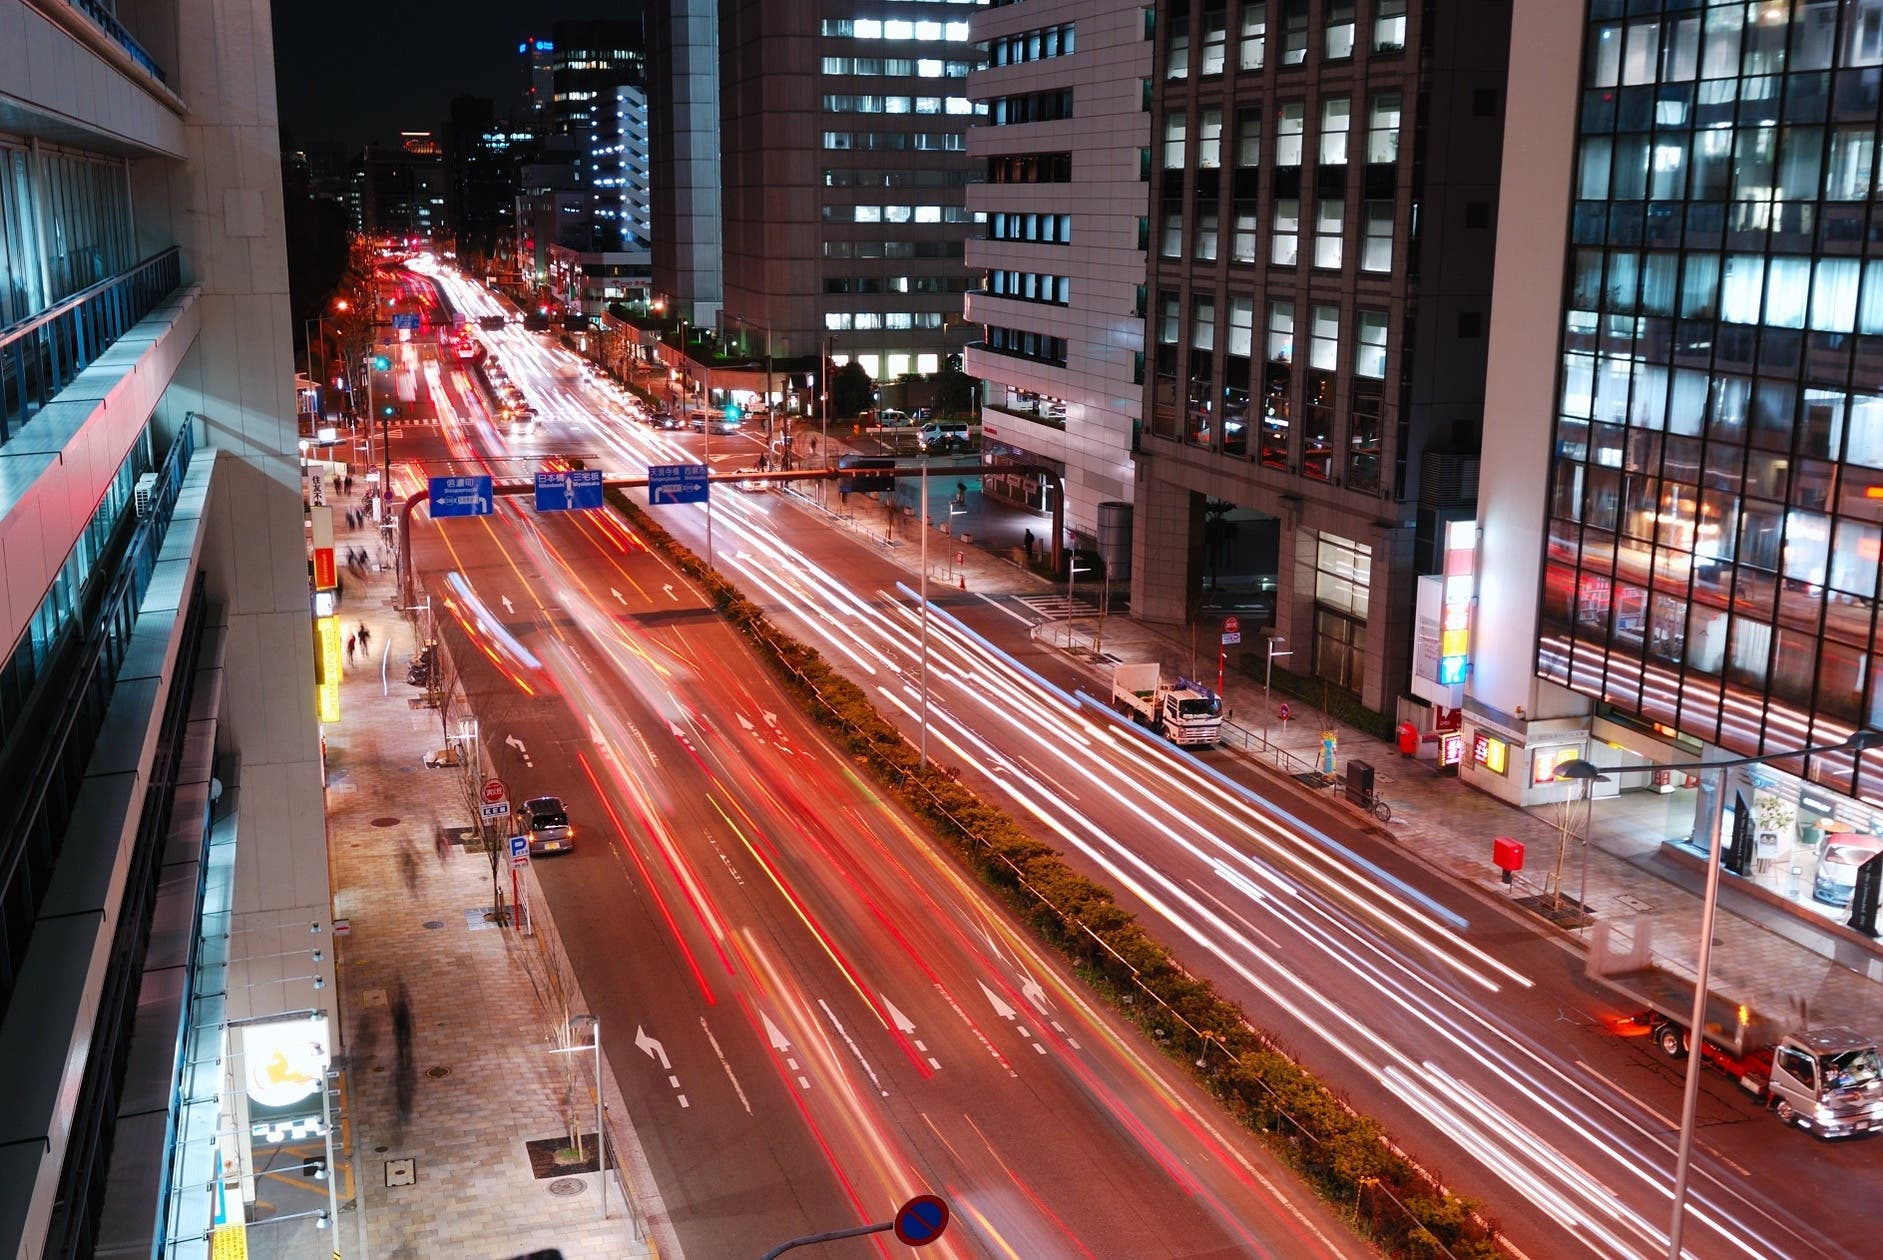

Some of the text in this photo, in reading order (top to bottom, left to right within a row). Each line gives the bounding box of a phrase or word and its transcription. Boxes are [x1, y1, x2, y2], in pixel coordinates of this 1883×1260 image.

[573, 472, 600, 481] 三宅坂
[511, 837, 526, 856] P
